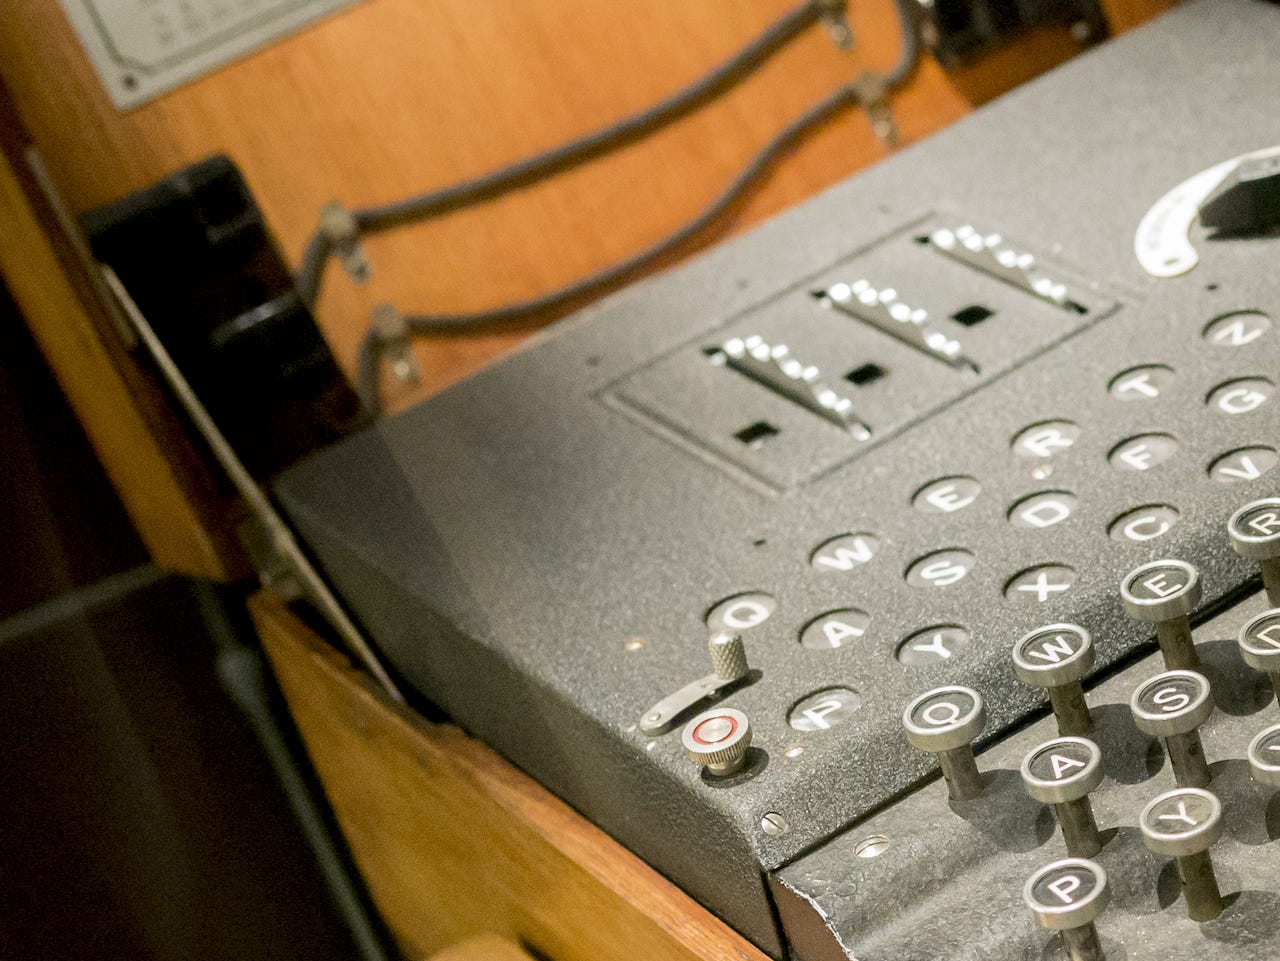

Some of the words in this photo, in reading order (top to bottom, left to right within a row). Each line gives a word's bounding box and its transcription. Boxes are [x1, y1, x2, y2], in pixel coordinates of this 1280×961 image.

[723, 601, 770, 628] Q
[819, 538, 873, 571] W
[933, 479, 979, 511] E
[1025, 428, 1073, 458] R
[1118, 373, 1160, 398] T
[1218, 321, 1265, 346] Z
[823, 620, 863, 648] A
[920, 562, 967, 585] S
[1021, 501, 1070, 527] D
[1120, 445, 1152, 470] F
[1219, 389, 1267, 414] G
[802, 700, 842, 729] P
[913, 635, 957, 658] Y
[1017, 573, 1070, 602] X
[1124, 518, 1170, 541] C
[1220, 457, 1261, 480] V
[924, 702, 962, 728] Q
[1029, 636, 1076, 663] W
[1144, 573, 1182, 597] E
[1050, 754, 1085, 779] A
[1154, 688, 1189, 711] S
[1048, 874, 1081, 903] P
[1159, 802, 1198, 826] Y
